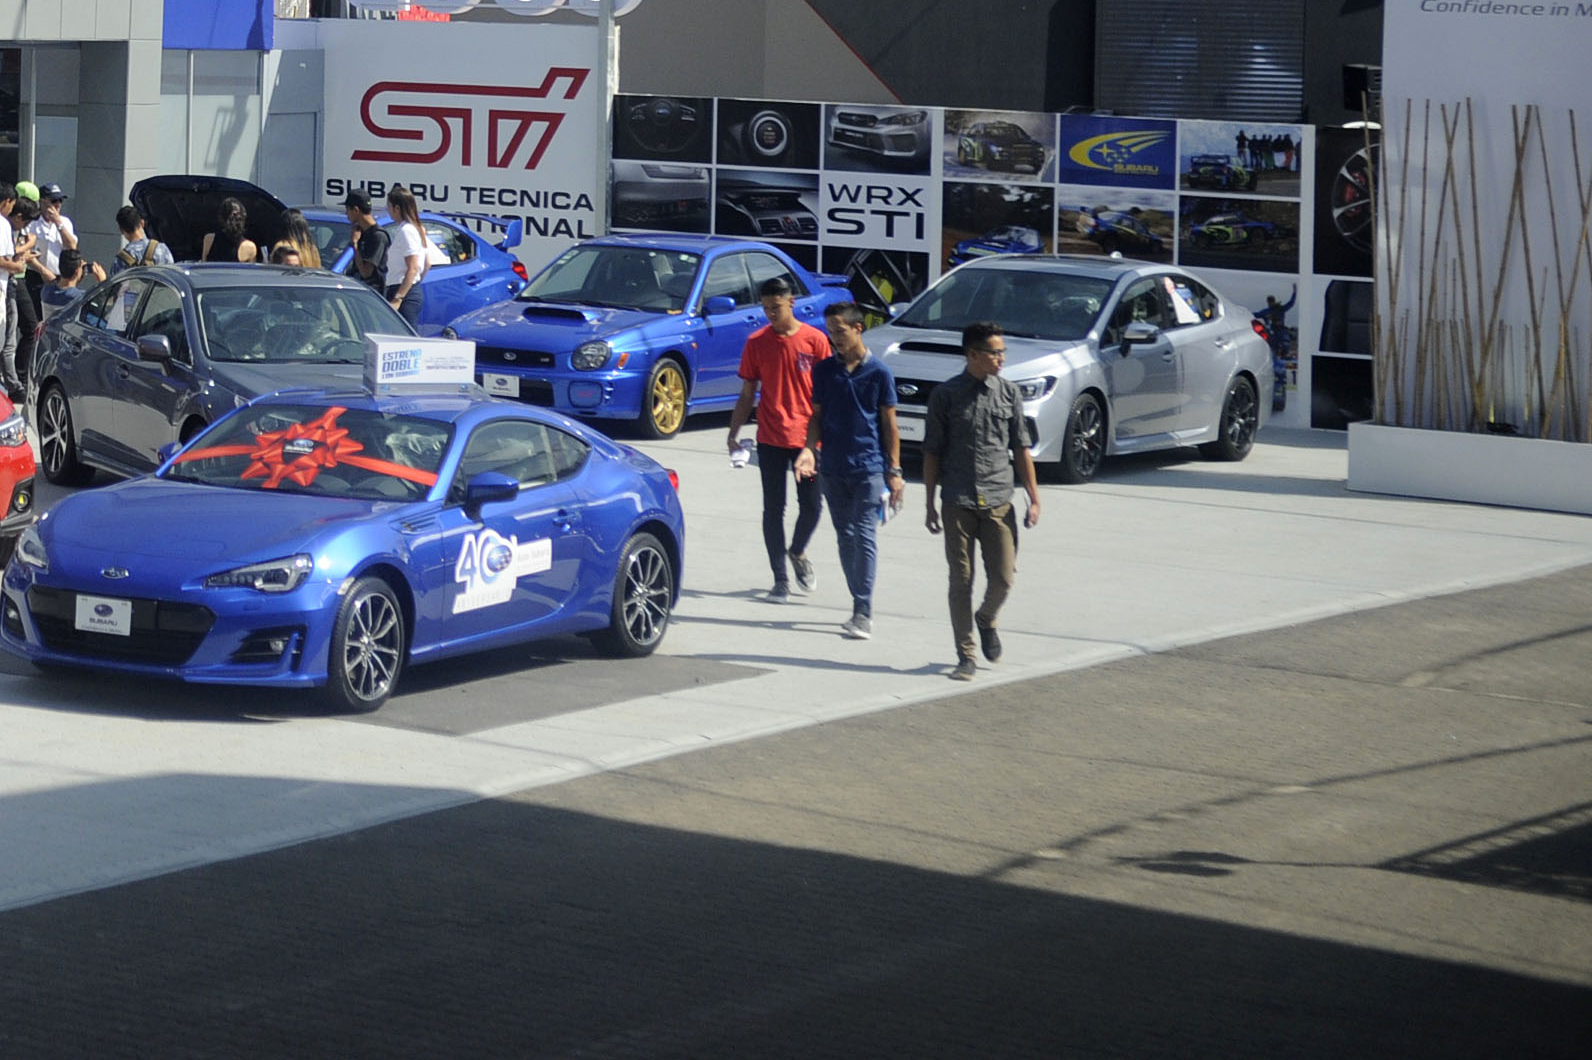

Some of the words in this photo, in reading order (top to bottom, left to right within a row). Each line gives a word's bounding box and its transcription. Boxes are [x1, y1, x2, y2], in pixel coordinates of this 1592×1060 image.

[1550, 2, 1569, 16] in
[461, 186, 594, 212] TECNICA
[828, 183, 924, 207] WRX
[827, 208, 924, 239] STI
[382, 358, 420, 373] DOBLE
